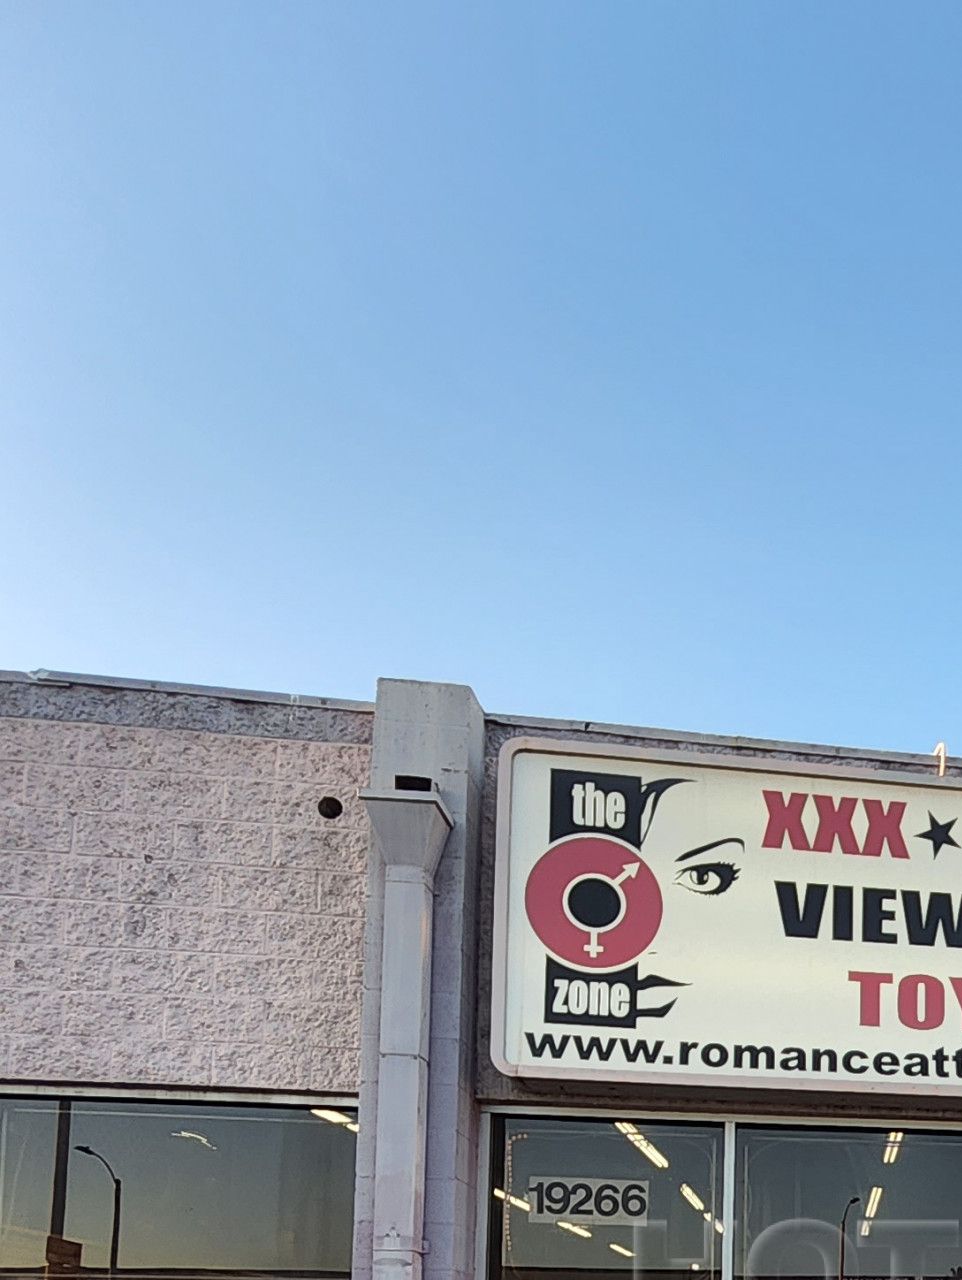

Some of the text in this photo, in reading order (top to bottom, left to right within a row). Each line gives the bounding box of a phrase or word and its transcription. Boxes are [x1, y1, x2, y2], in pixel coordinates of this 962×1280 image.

[570, 781, 626, 829] the
[760, 789, 911, 860] XXX
[552, 977, 631, 1019] zone
[528, 1180, 647, 1217] 19266
